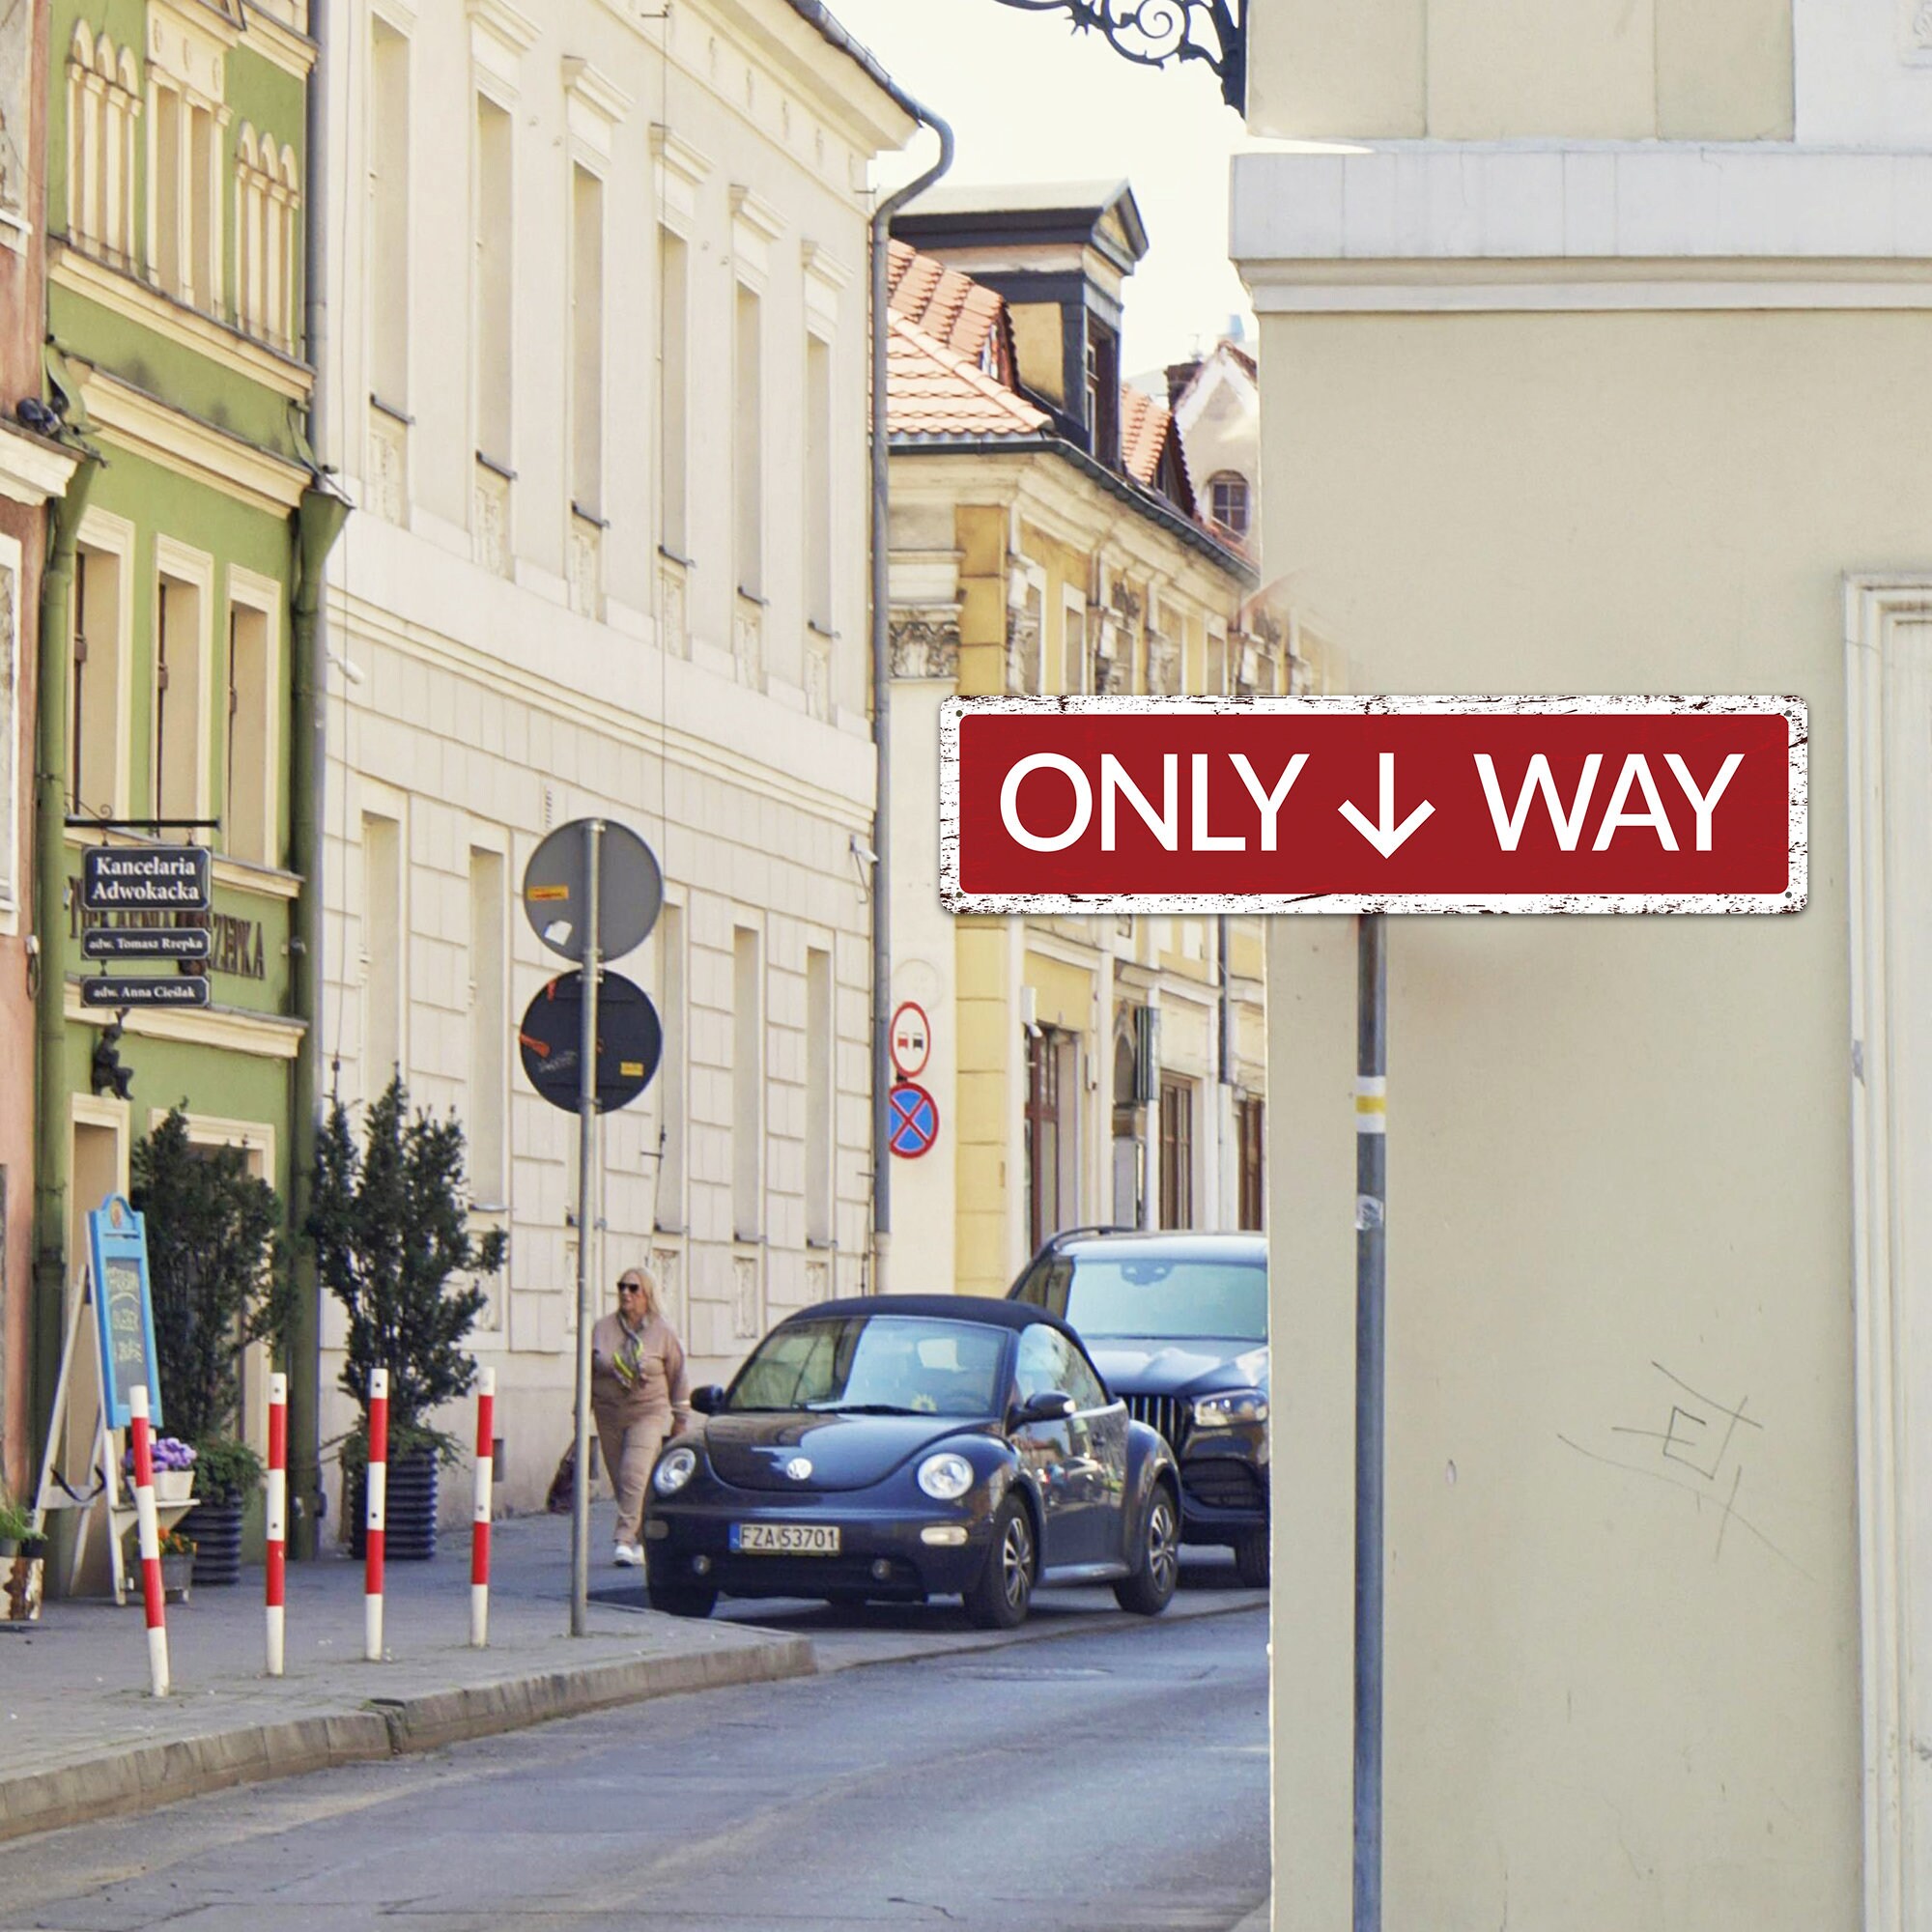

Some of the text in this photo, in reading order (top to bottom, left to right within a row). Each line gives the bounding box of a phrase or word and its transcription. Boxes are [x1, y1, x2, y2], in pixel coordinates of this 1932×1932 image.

[1000, 753, 1745, 852] ONLY WAY
[96, 856, 196, 876] Kancelaria
[92, 880, 200, 900] Adwokacka
[117, 938, 159, 950] Tomasz
[121, 986, 152, 998] Anna
[741, 1526, 836, 1548] FZA 53701
